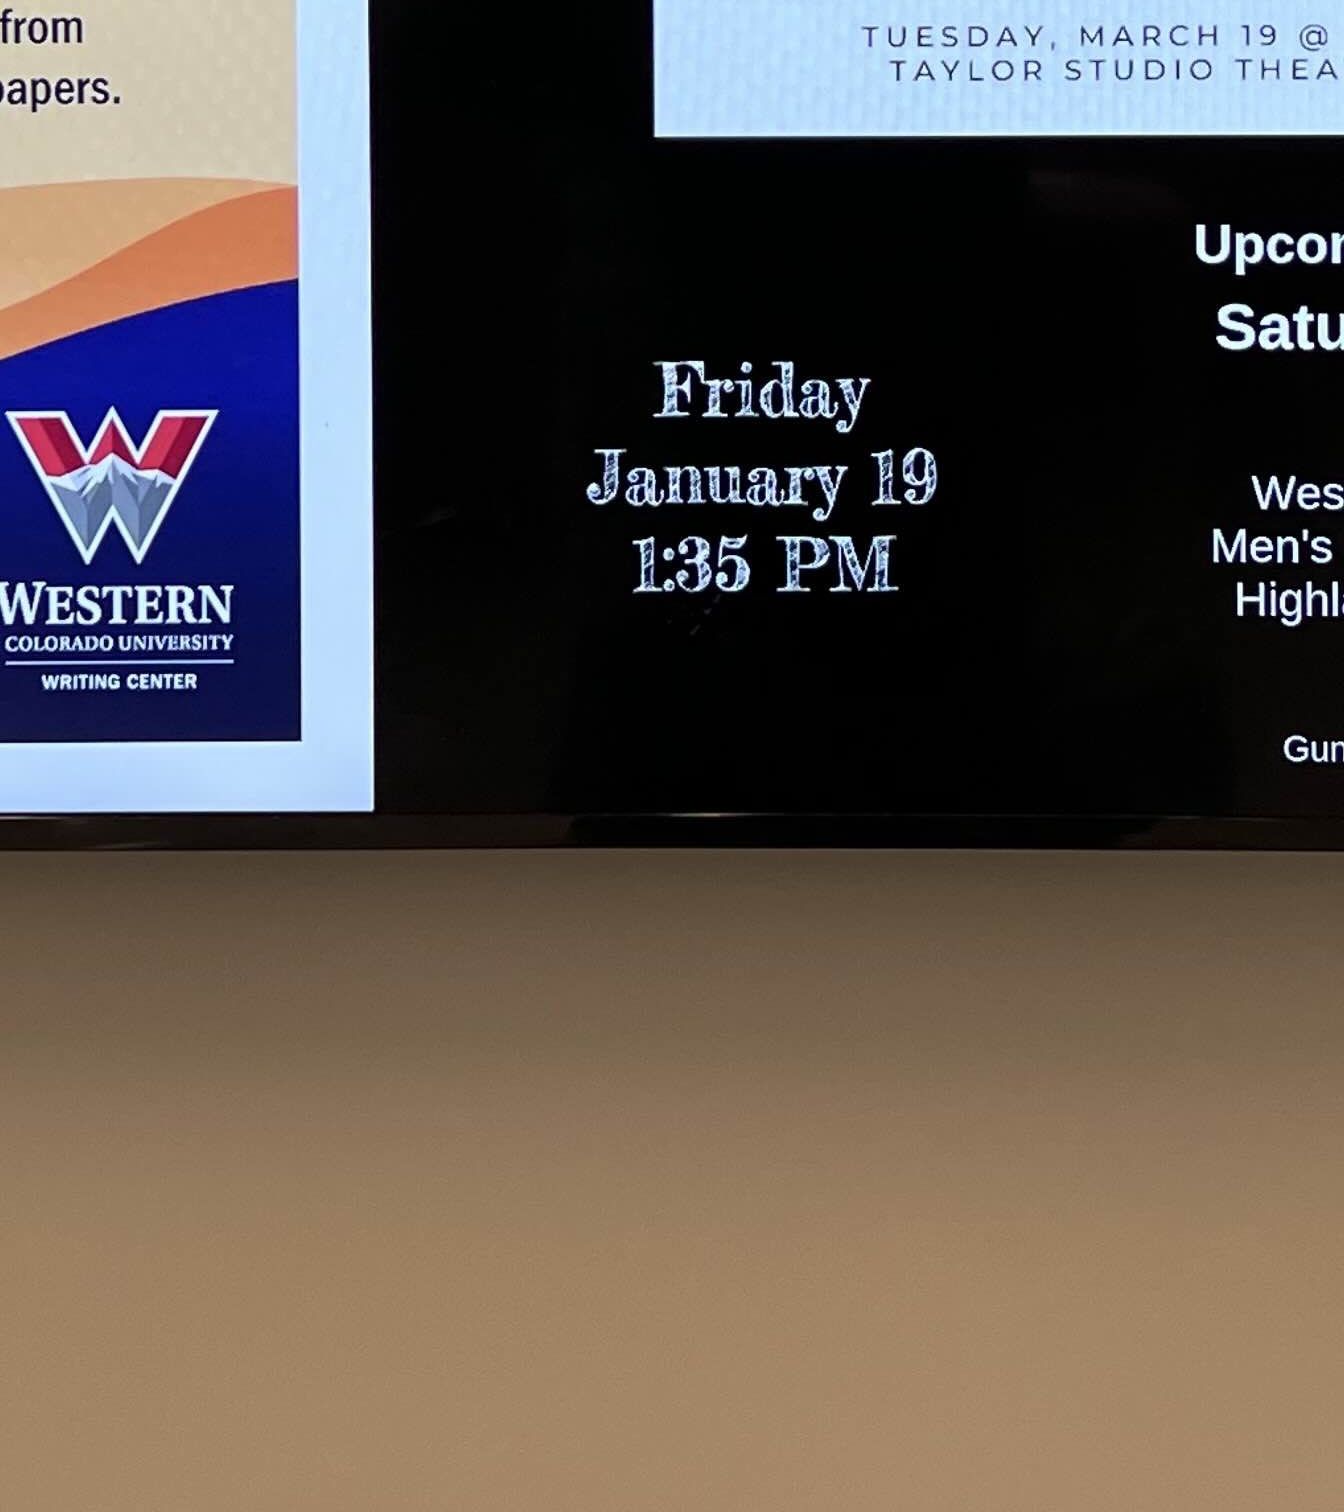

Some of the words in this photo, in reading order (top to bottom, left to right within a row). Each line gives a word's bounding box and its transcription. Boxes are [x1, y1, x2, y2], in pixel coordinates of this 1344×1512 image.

[862, 26, 1055, 50] TUESDAY,
[1081, 25, 1217, 46] MARCH
[1242, 25, 1276, 46] 19
[1299, 24, 1328, 51] @
[890, 60, 1041, 81] TAYLOR
[1065, 59, 1212, 81] STUDIO
[653, 361, 871, 432] Friday
[587, 449, 848, 521] January
[871, 448, 937, 505] 19
[1213, 529, 1332, 563] Men's
[633, 535, 750, 592] 1:35
[776, 535, 899, 592] PM
[5, 635, 113, 652] COLORADO
[119, 634, 233, 651] UNIVERSITY
[41, 674, 120, 690] WRITING
[127, 674, 197, 689] CENTER
